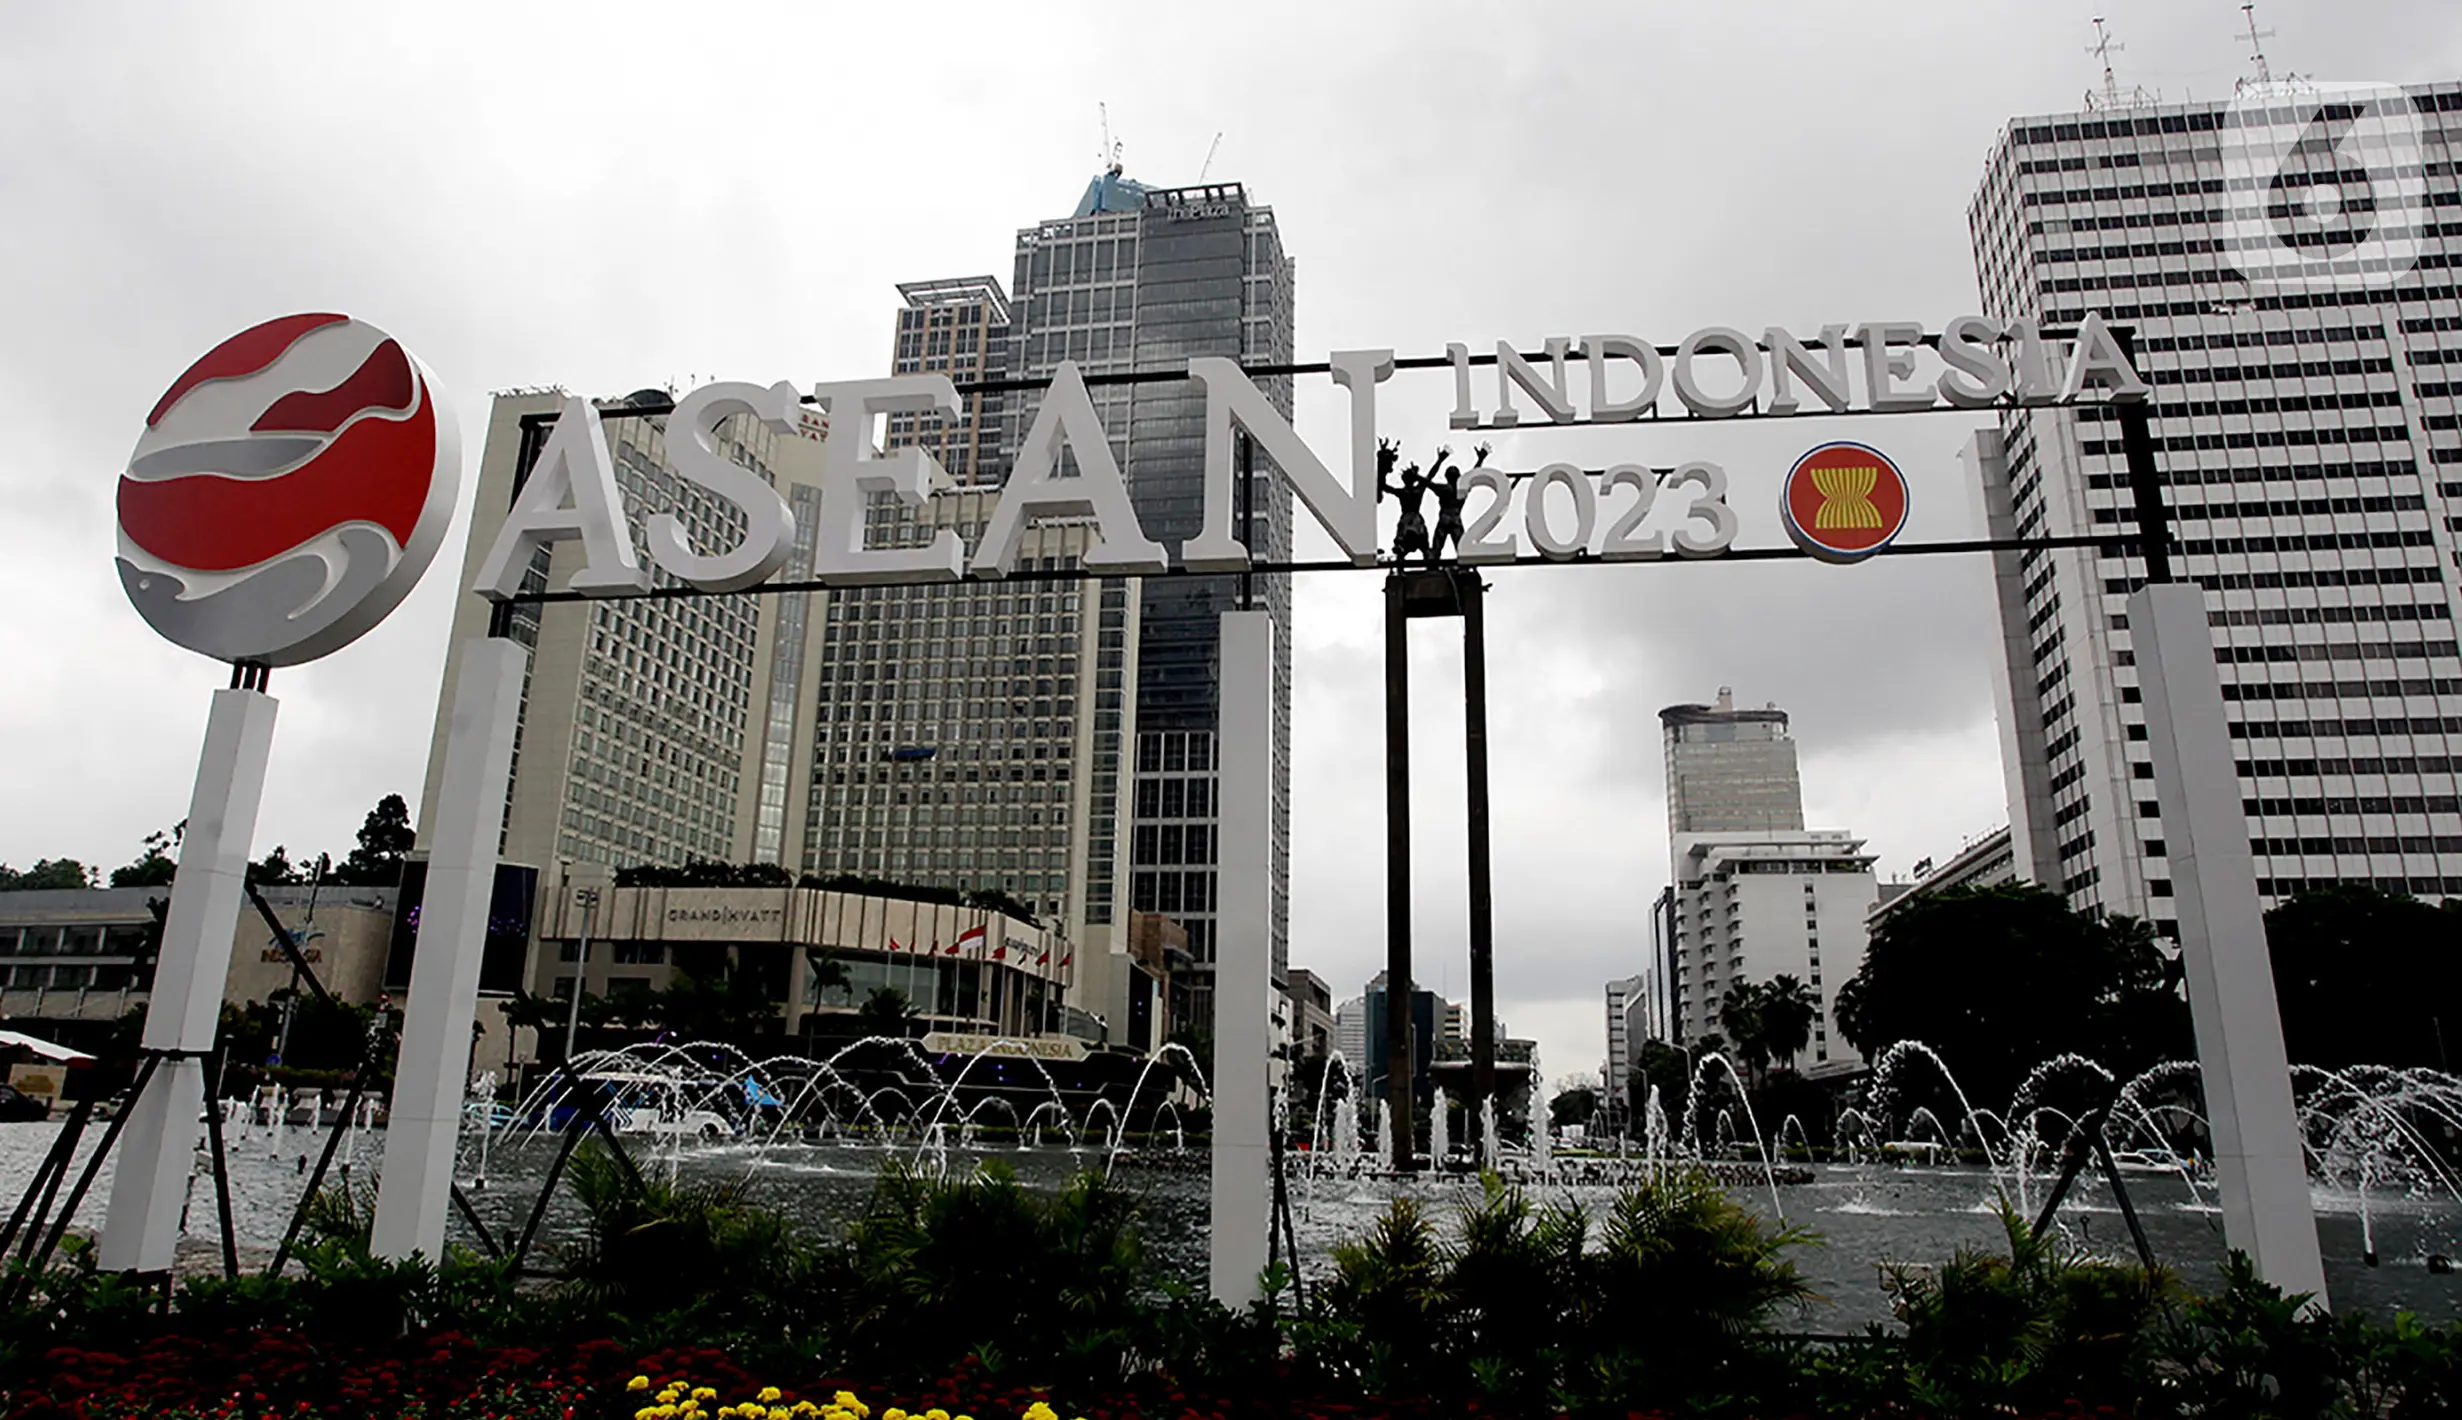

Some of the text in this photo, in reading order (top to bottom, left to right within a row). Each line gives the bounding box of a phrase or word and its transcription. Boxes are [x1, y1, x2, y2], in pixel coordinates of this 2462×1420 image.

[1446, 311, 2149, 429] INDONESIA
[474, 349, 1394, 600] ASEAN
[1457, 461, 1738, 564] 2023
[668, 908, 781, 922] GRAND HYATT
[936, 1036, 989, 1053] PLAZA
